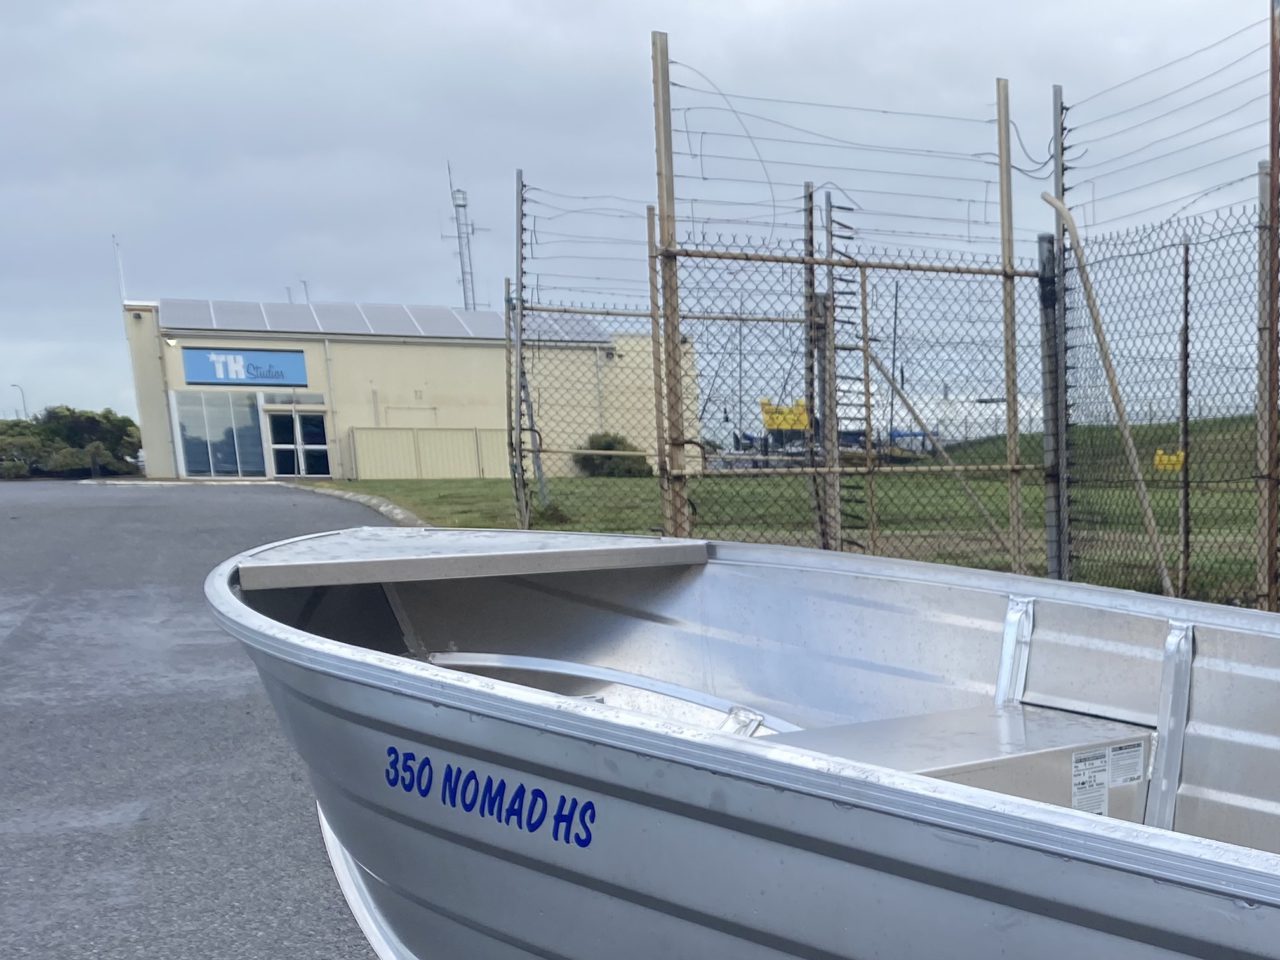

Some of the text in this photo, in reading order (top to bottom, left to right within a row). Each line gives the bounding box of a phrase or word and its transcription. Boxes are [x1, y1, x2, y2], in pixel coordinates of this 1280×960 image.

[207, 352, 246, 379] TH
[385, 746, 597, 848] 350 NOMAD HS
